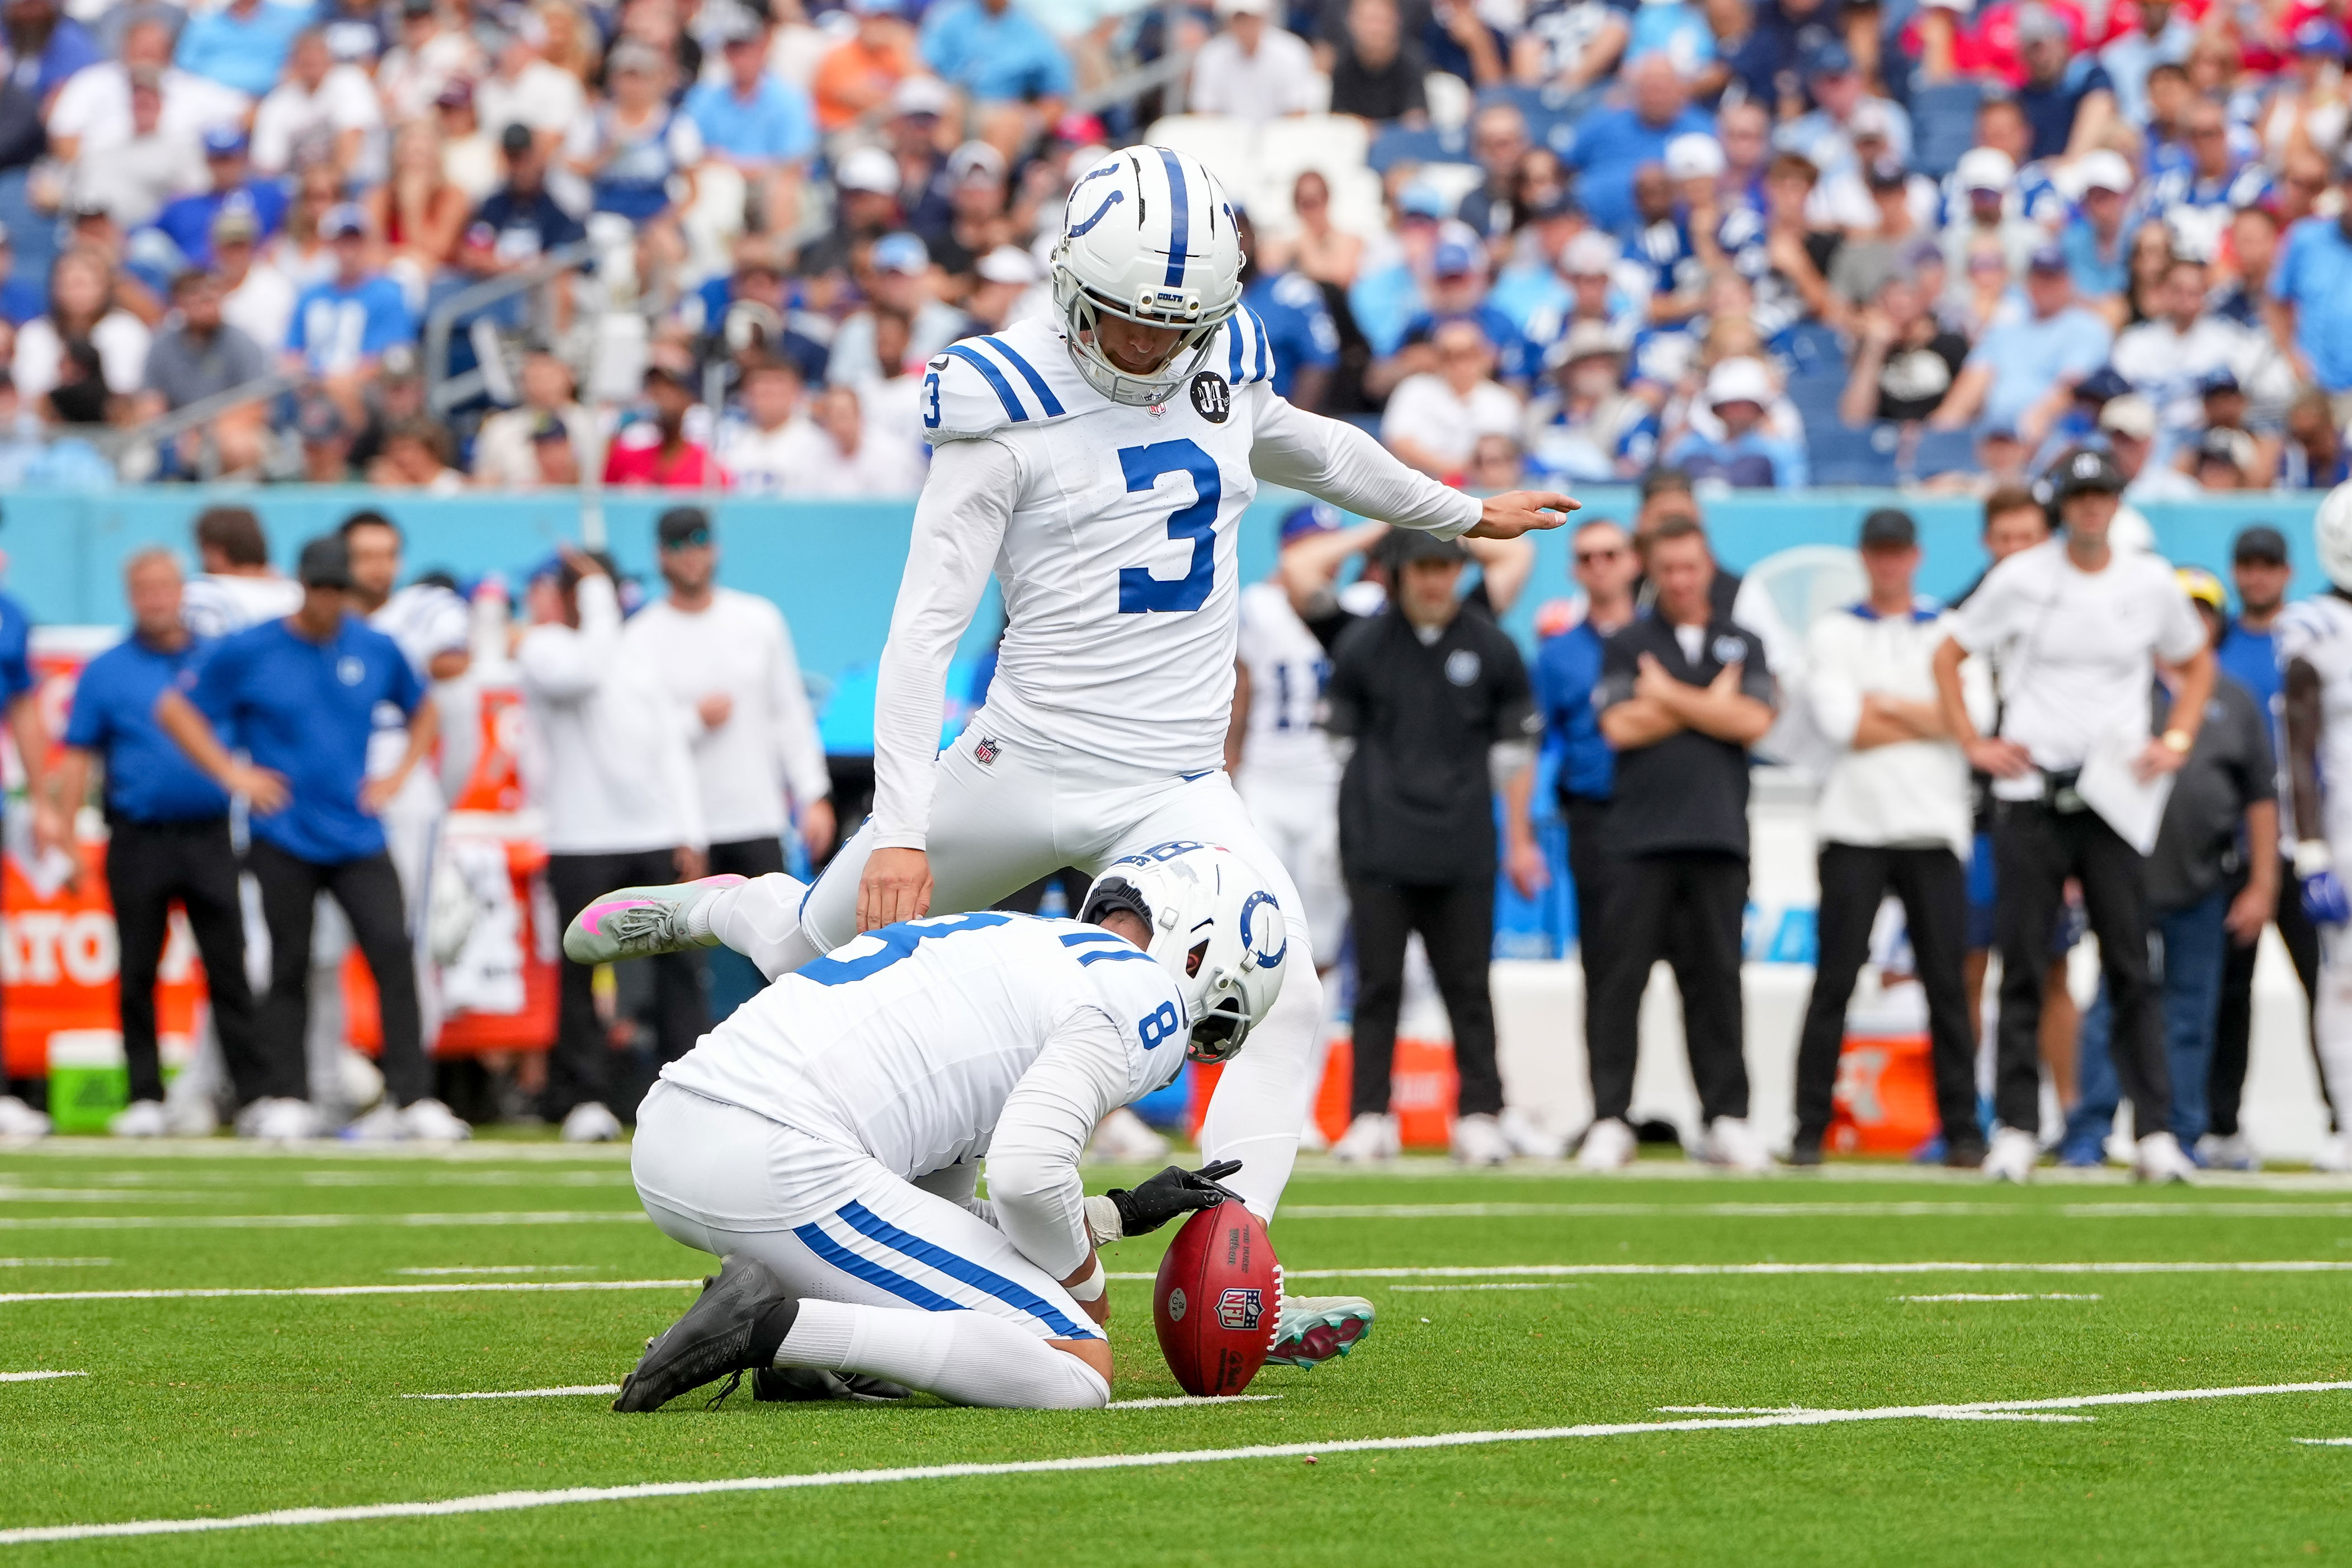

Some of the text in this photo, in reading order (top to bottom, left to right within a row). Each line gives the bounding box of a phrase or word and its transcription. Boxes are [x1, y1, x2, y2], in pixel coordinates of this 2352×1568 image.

[1157, 292, 1183, 303] COLTS
[923, 372, 941, 428] 3
[1150, 403, 1165, 414] NFL
[1117, 438, 1221, 613] 3
[976, 745, 993, 763] NFL
[1139, 1000, 1178, 1051] 8
[1228, 1228, 1240, 1265] Wilson
[1222, 1293, 1245, 1325] NFL
